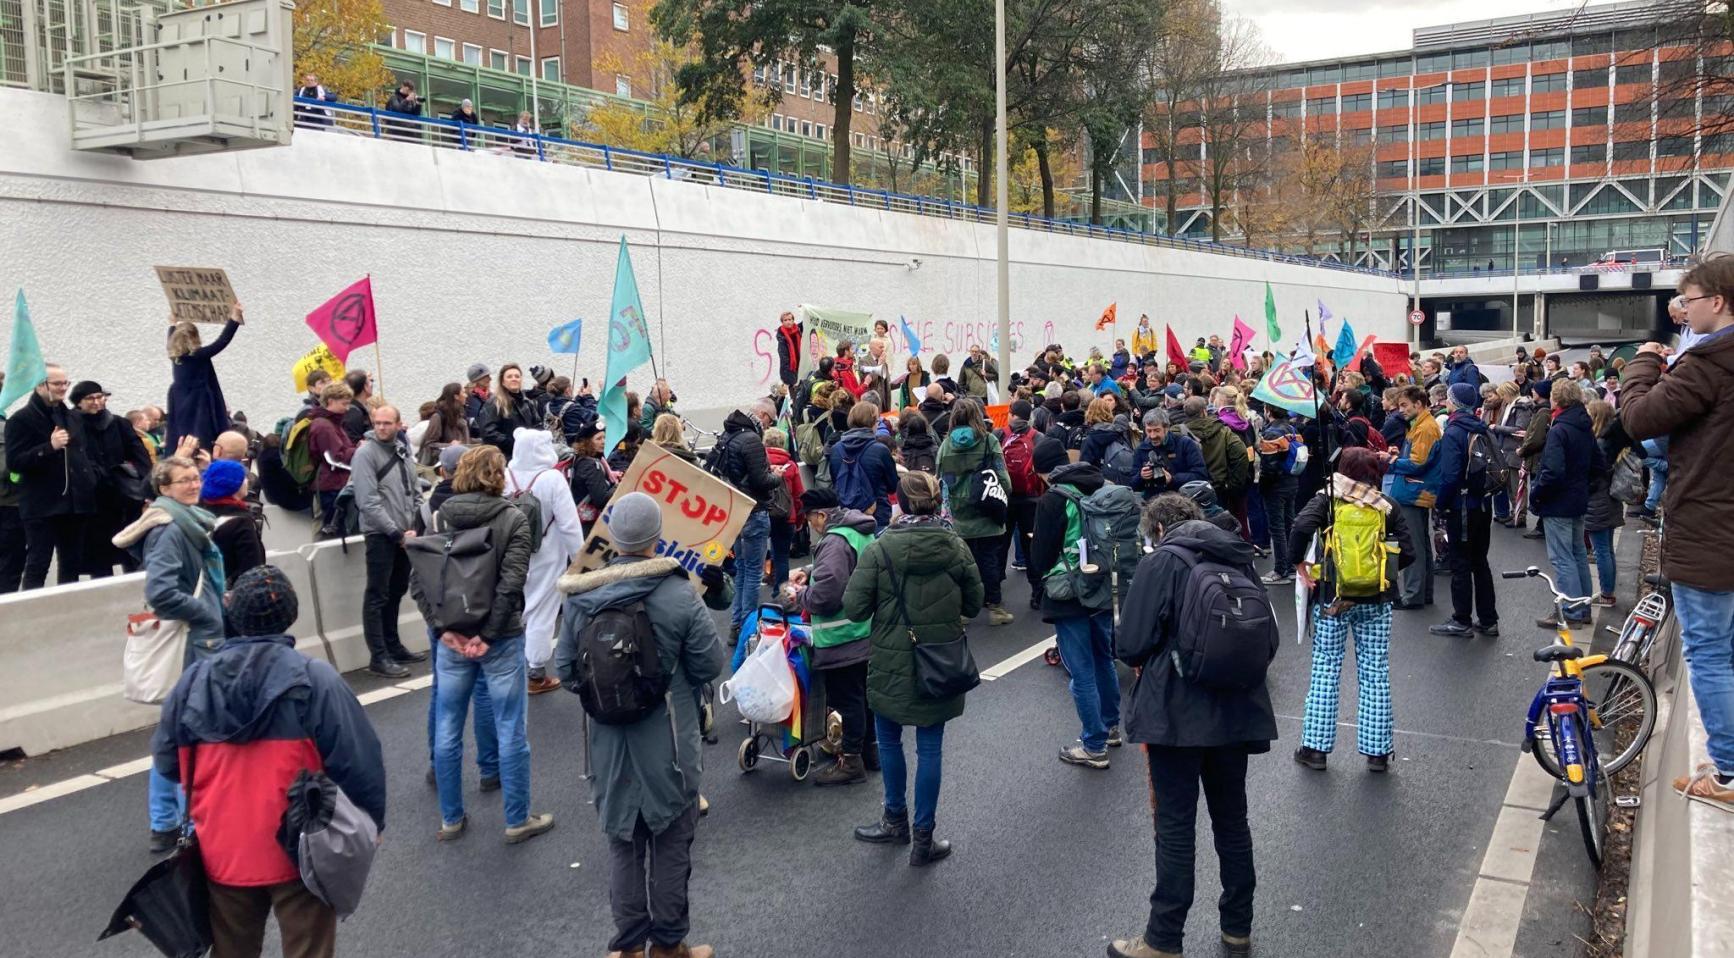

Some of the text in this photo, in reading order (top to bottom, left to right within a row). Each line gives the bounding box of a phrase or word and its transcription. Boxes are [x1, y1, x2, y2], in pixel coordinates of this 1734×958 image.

[196, 272, 226, 287] MAAR
[171, 287, 230, 303] KLIMAAT-
[643, 469, 727, 527] STOP
